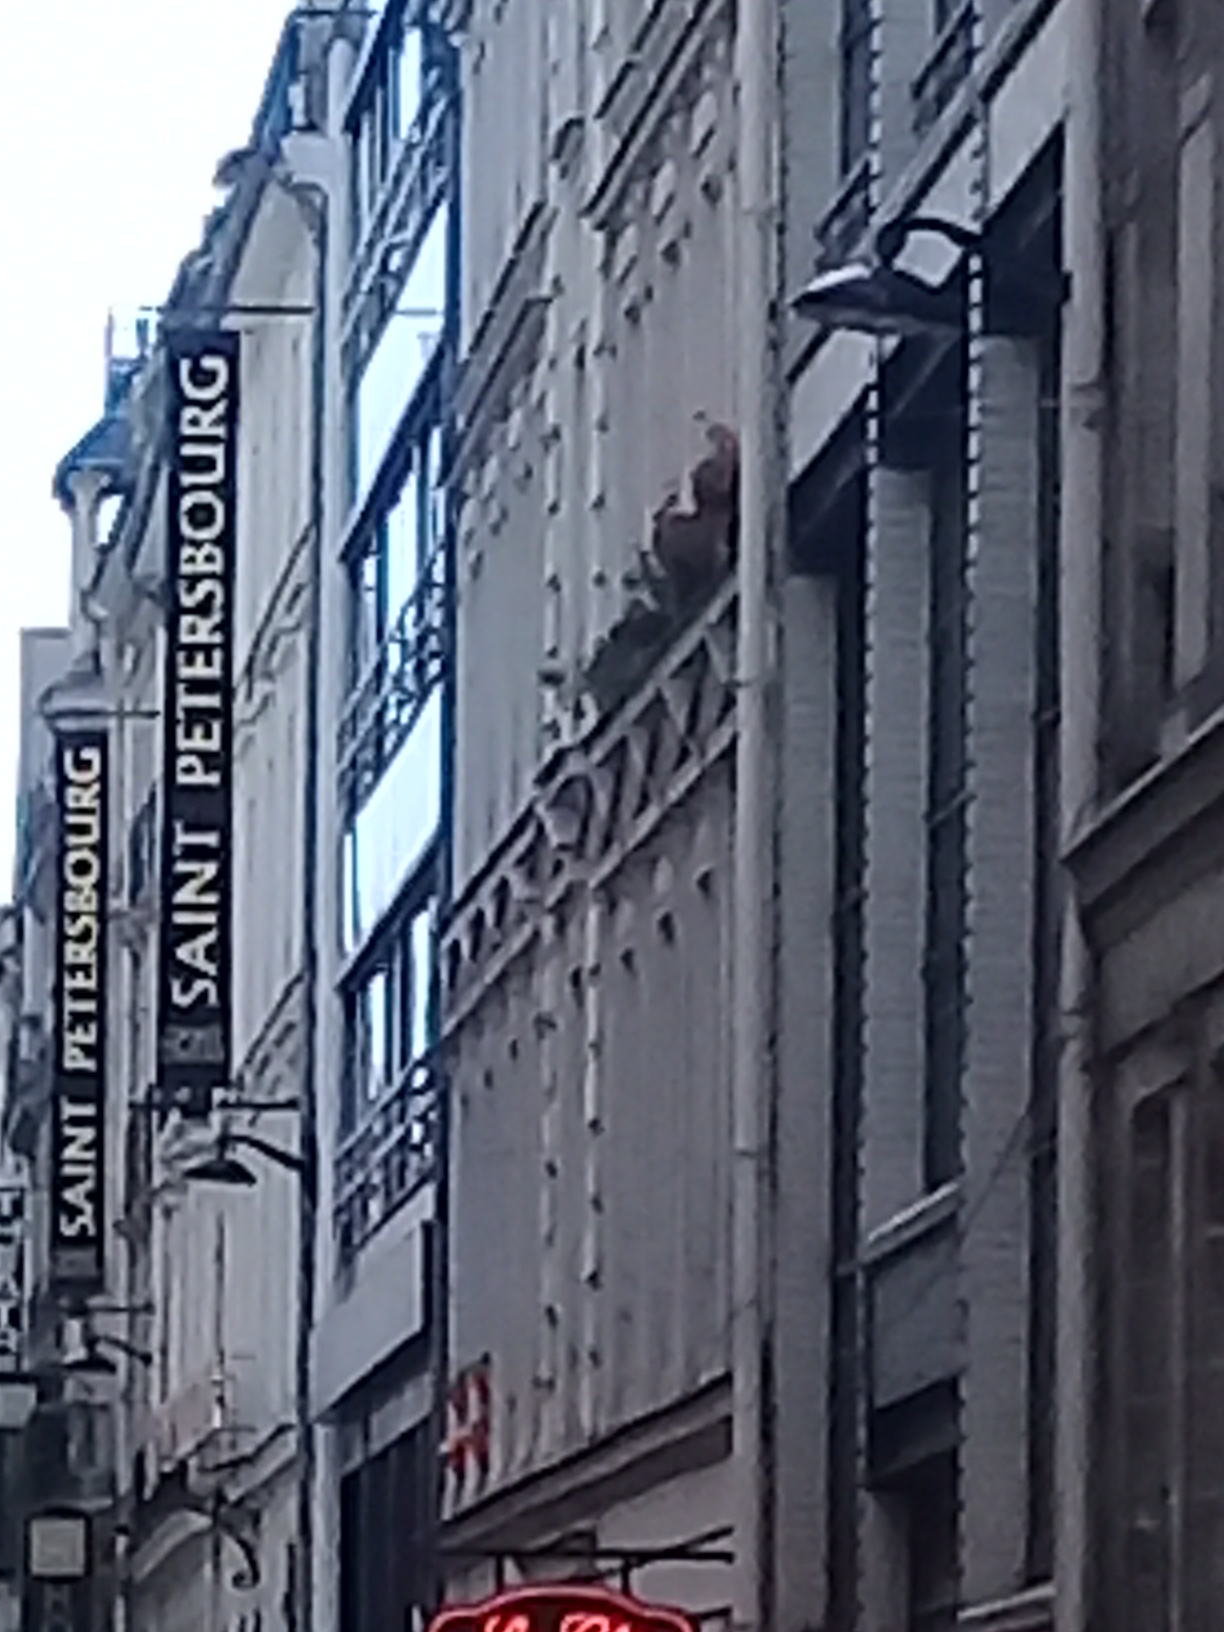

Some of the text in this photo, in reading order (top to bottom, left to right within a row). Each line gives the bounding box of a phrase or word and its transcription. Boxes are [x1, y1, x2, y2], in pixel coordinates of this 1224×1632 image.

[170, 353, 231, 1009] SAINT PETERSBOURG
[58, 744, 102, 1237] SAINT PETERSBOURG
